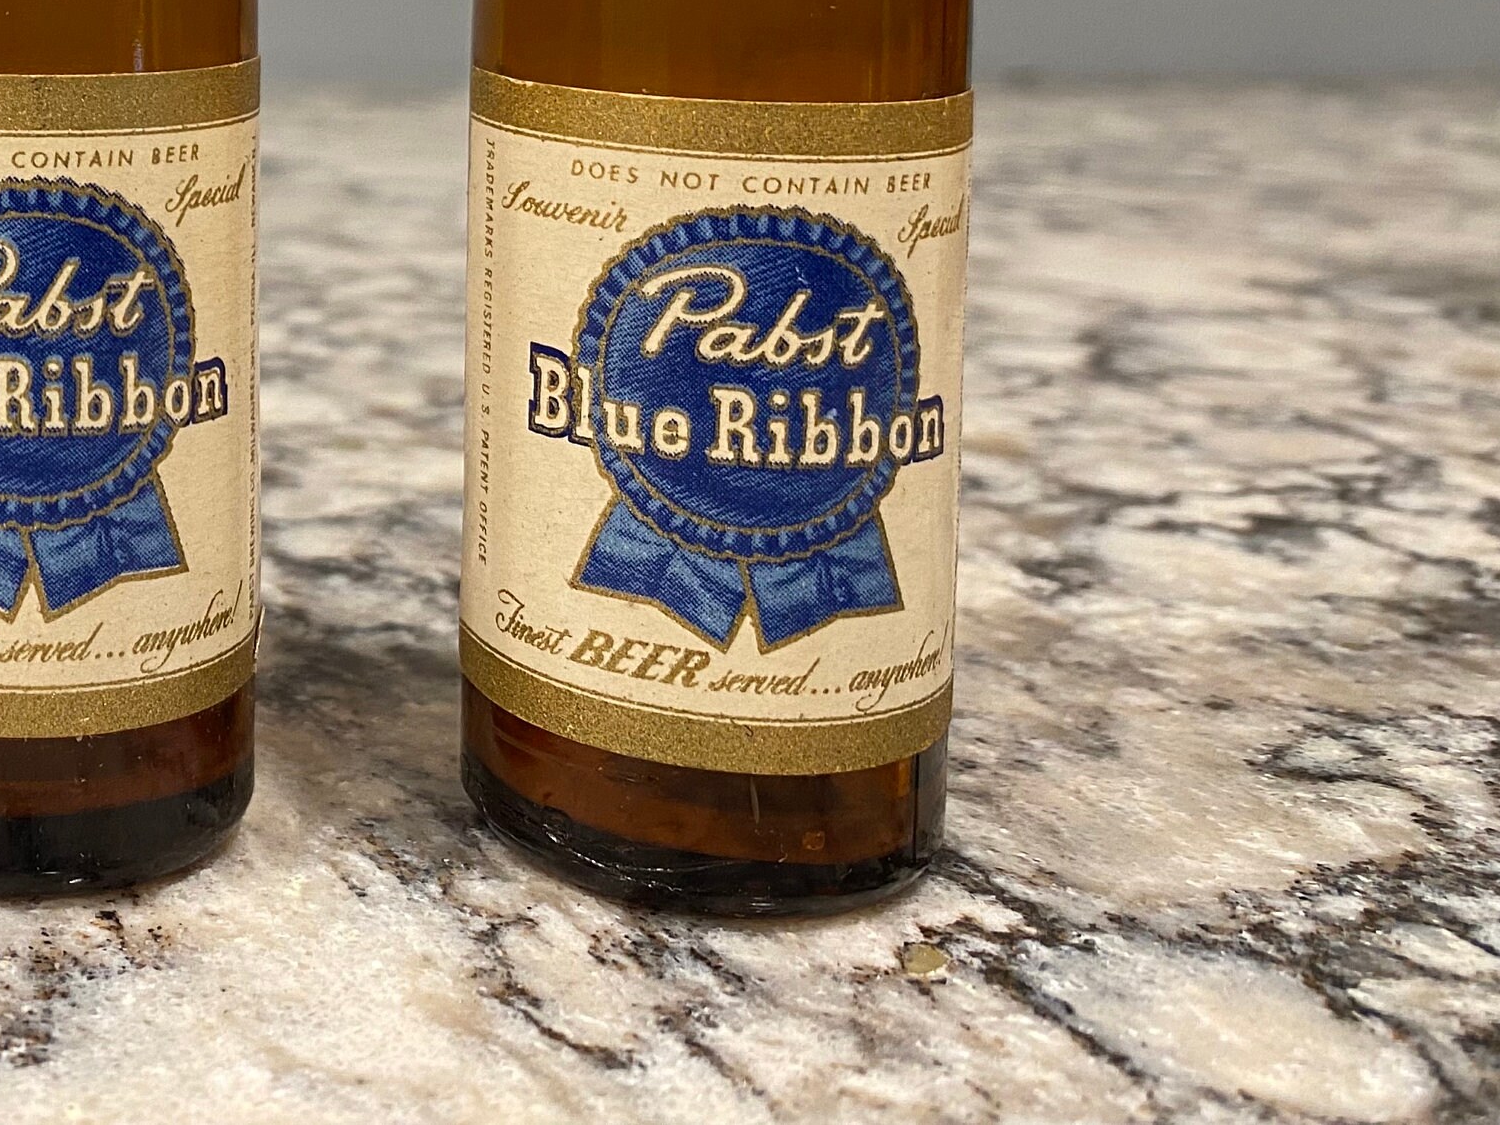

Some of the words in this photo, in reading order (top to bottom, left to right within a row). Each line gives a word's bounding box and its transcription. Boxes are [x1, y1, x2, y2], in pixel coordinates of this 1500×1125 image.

[11, 149, 134, 169] CONTAIN
[151, 143, 200, 165] BEER
[571, 159, 639, 183] DOES
[661, 171, 719, 192] NOT
[742, 175, 869, 196] CONTAIN
[886, 172, 931, 193] BEER
[165, 163, 246, 225] Special
[484, 138, 496, 259] TRADEMARKS
[500, 180, 628, 233] Souvenir
[898, 192, 965, 259] Special
[482, 266, 493, 375] REGISTERED
[638, 265, 888, 368] Pabst
[528, 340, 693, 460] Blue
[705, 386, 945, 470] Ribbon
[479, 428, 490, 494] PATENT
[477, 500, 489, 566] OFFICE
[494, 588, 573, 656] Finest
[567, 627, 710, 690] BEER
